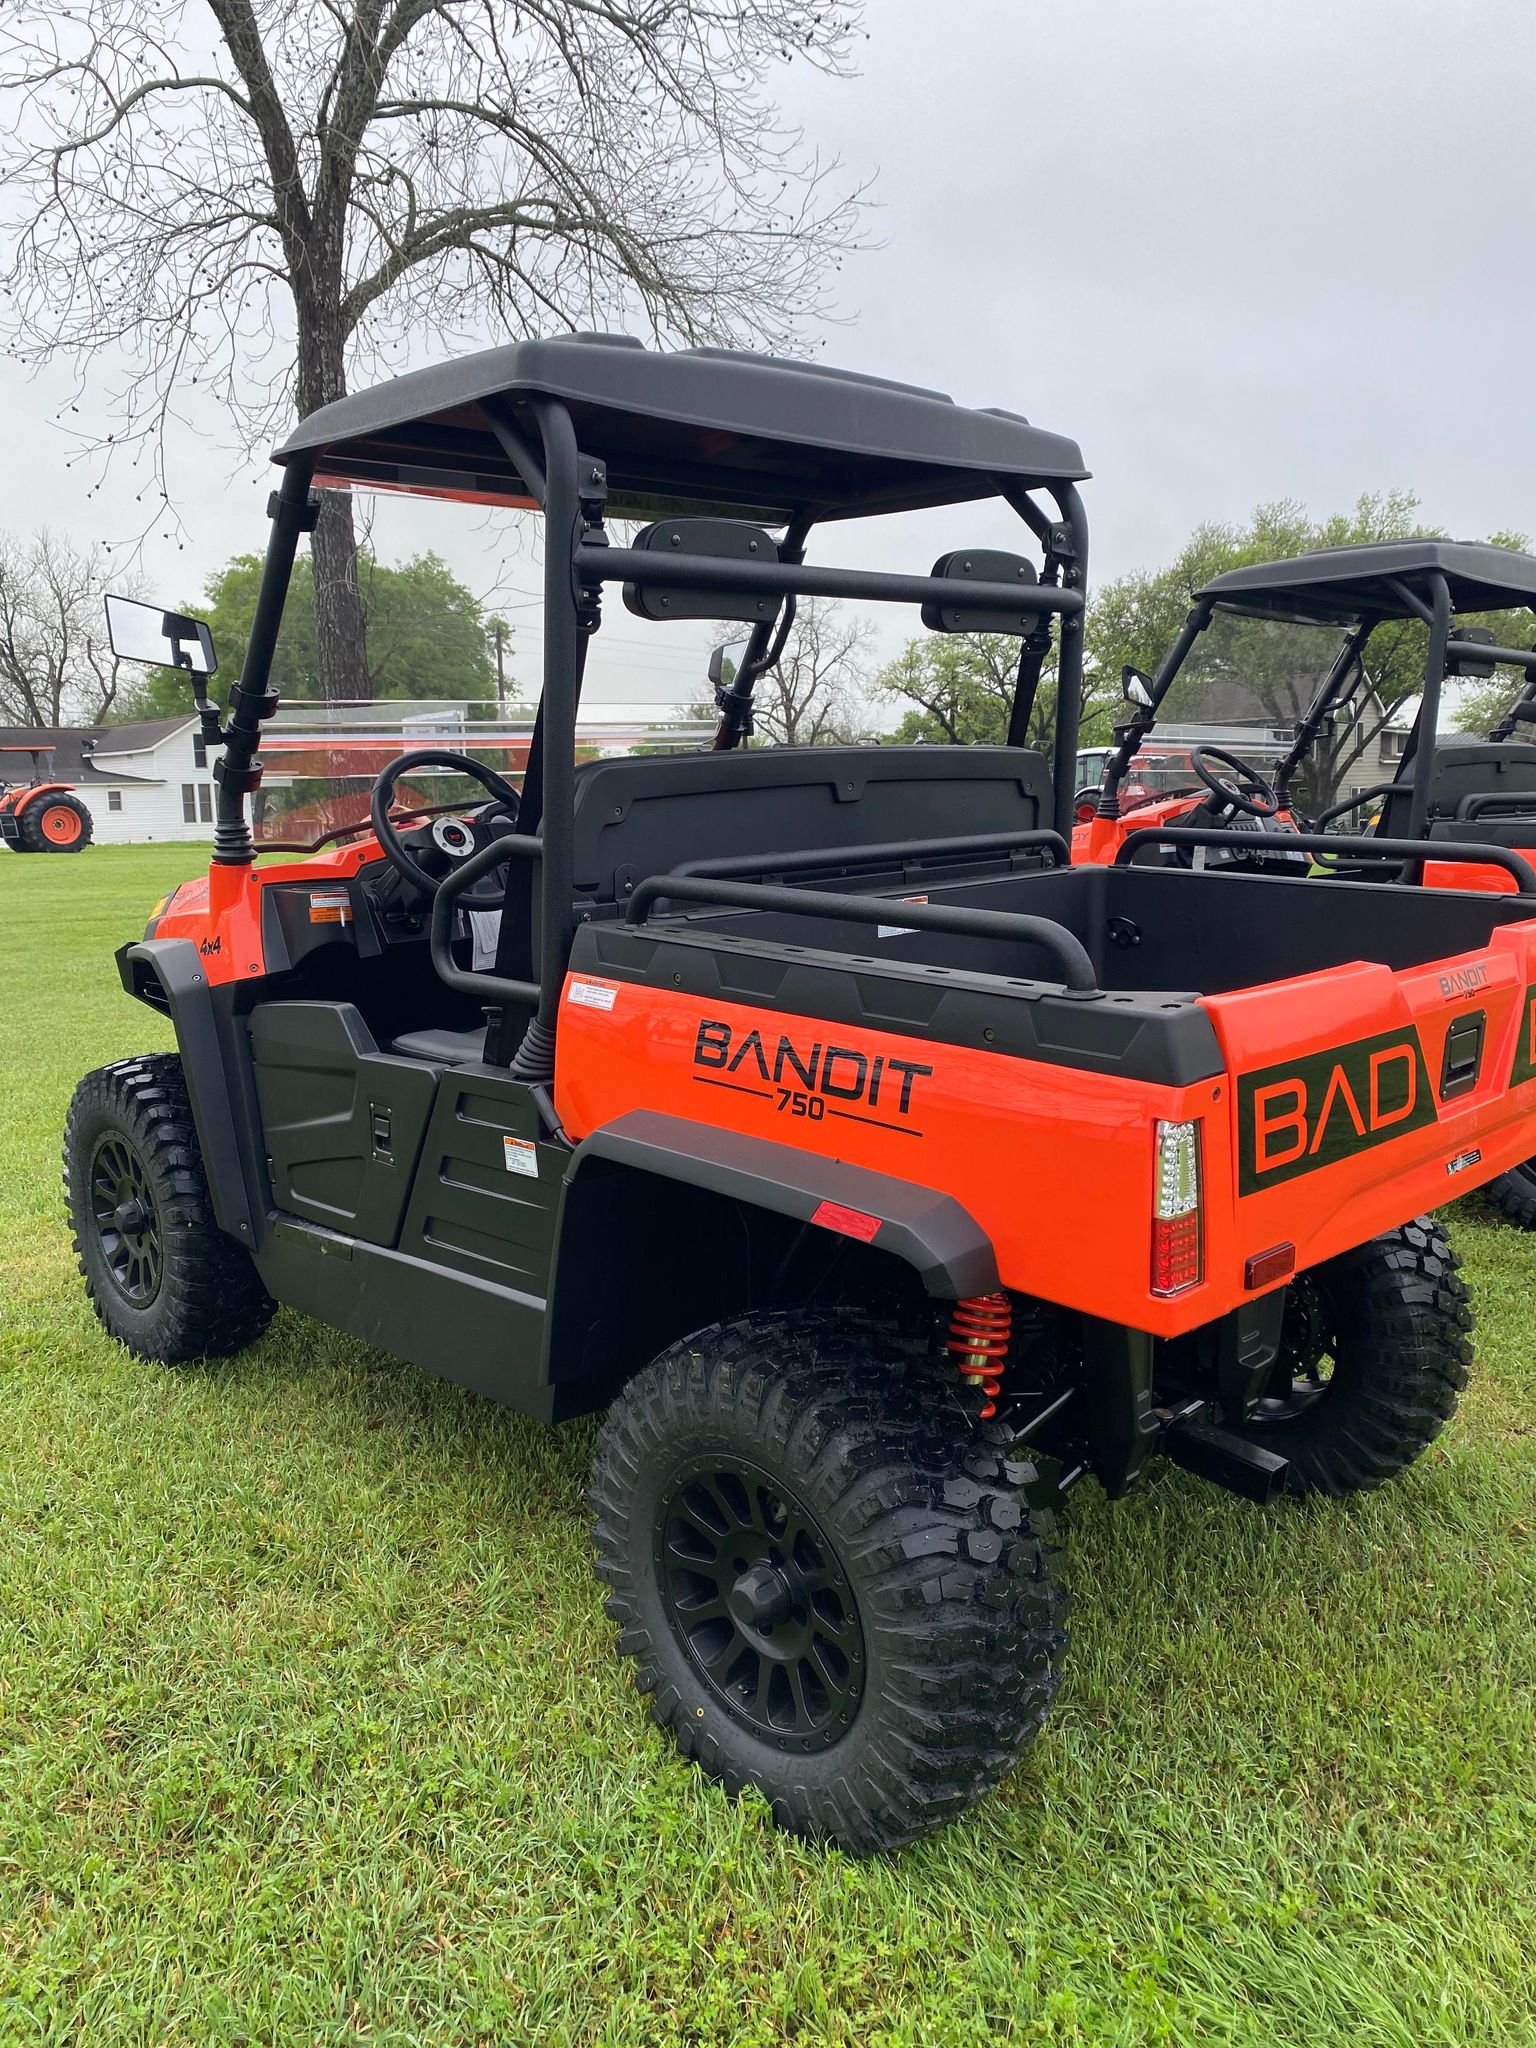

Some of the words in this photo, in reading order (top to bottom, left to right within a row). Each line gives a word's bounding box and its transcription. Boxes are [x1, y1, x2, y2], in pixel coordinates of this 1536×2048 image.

[200, 936, 222, 956] 4x4
[1439, 965, 1487, 996] BANDIT
[694, 1019, 933, 1114] BANDIT
[776, 1087, 825, 1121] 750
[1254, 1043, 1417, 1174] BAD
